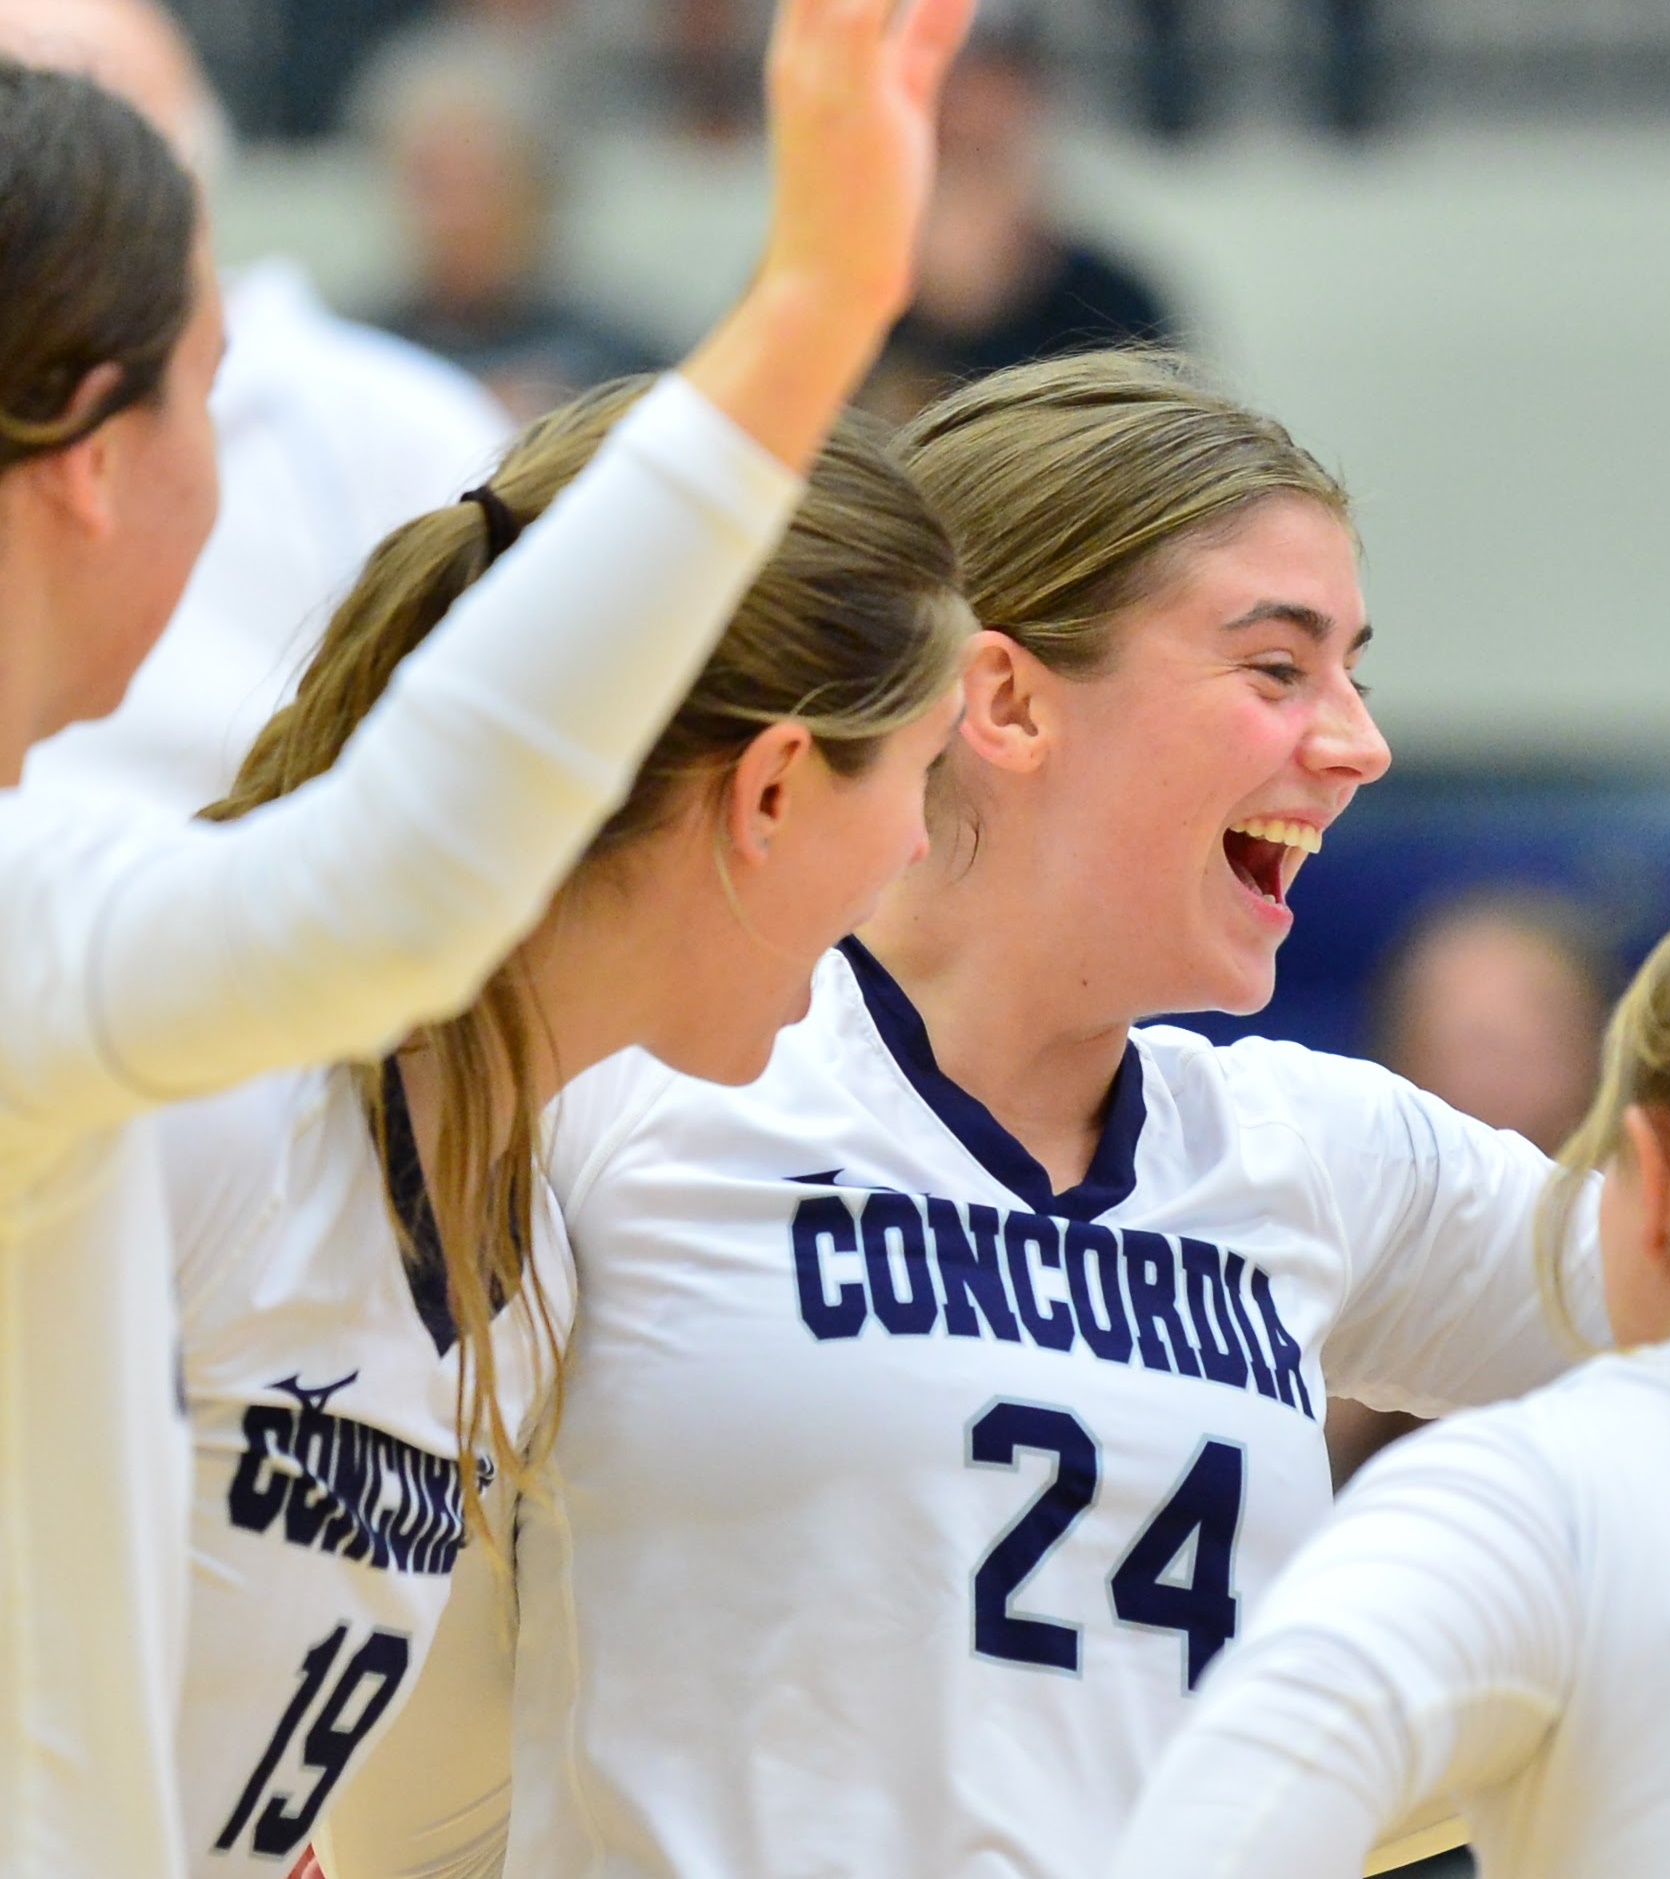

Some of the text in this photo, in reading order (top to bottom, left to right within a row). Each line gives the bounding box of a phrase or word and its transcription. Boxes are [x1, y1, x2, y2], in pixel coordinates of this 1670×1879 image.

[789, 1192, 1318, 1423] CONCORDIA
[964, 1396, 1247, 1698] 24
[210, 1620, 412, 1860] 19
